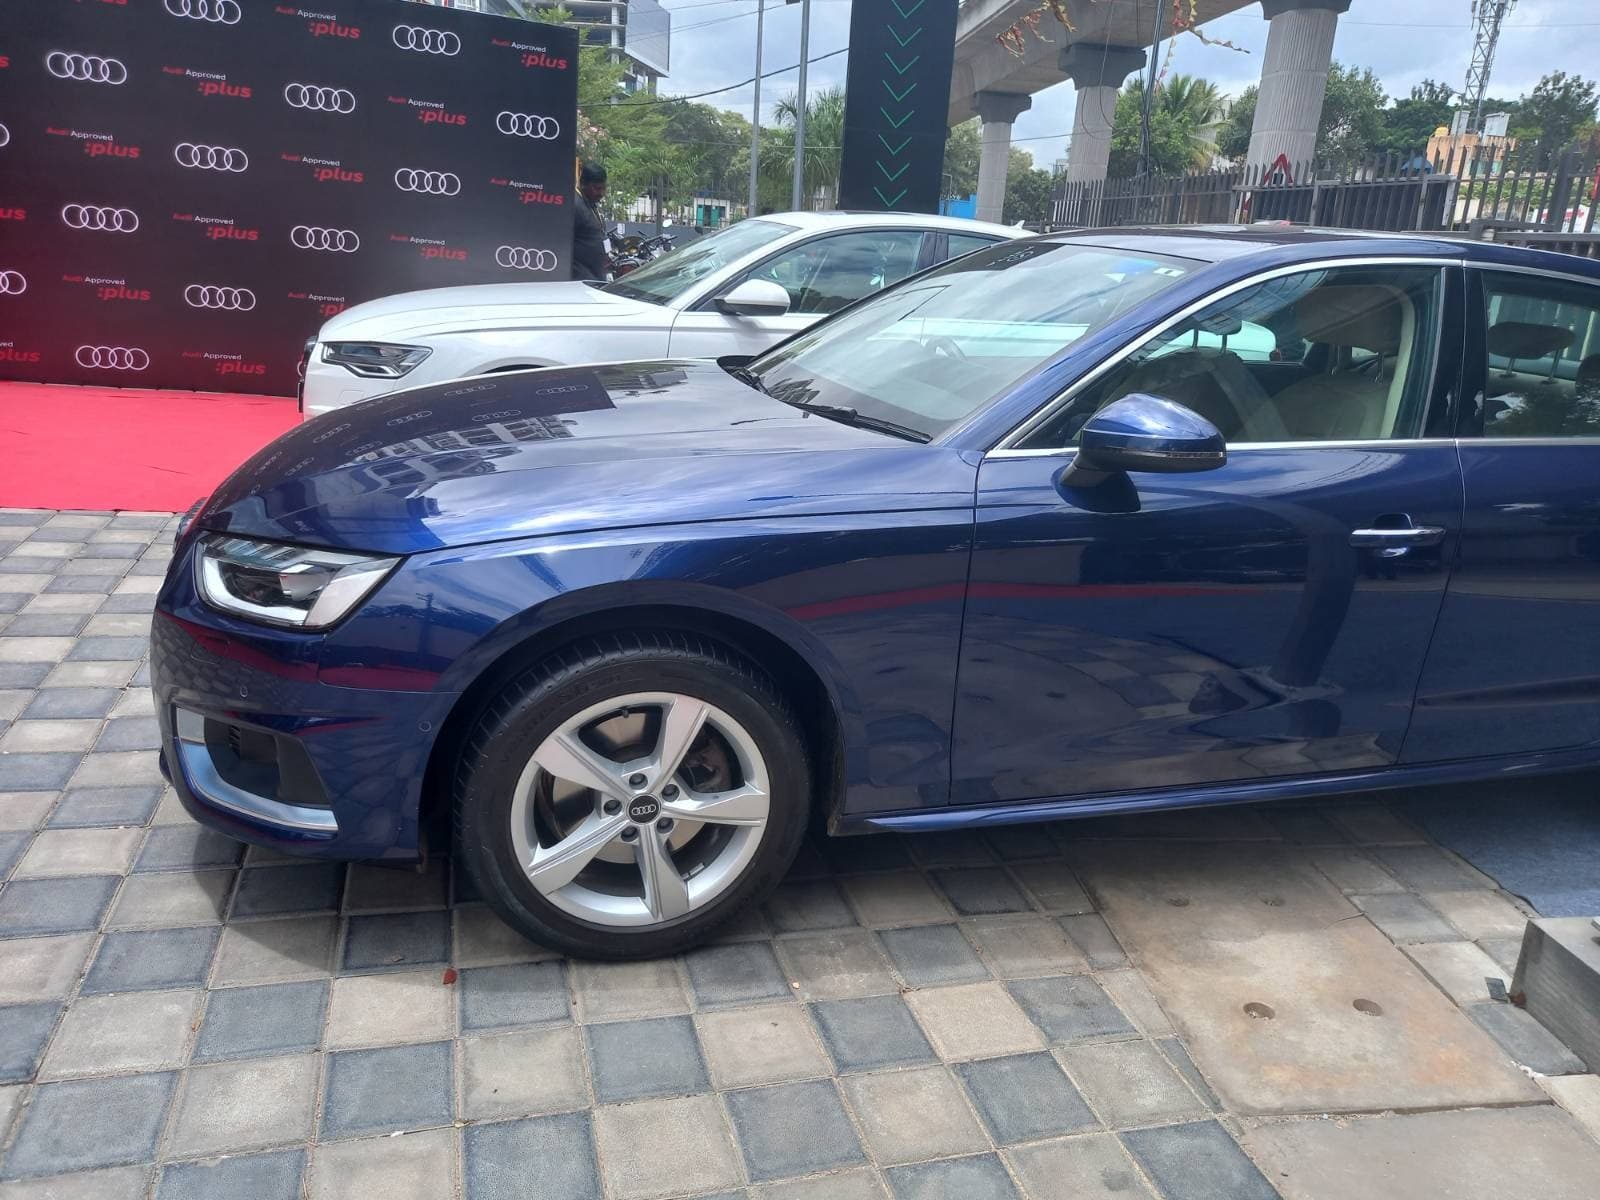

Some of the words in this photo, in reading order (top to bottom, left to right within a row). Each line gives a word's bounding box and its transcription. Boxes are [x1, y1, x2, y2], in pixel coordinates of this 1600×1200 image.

[297, 9, 336, 21] Approved
[511, 41, 546, 53] Approved
[185, 69, 226, 81] Approved
[408, 98, 444, 110] Approved
[71, 130, 113, 142] Approved
[302, 156, 340, 167] Approved
[509, 180, 544, 191] Approved
[195, 215, 234, 225] Approved
[410, 236, 446, 246] Approved
[84, 276, 125, 286] Approved
[308, 293, 345, 302] Approved
[203, 352, 242, 361] Approved
